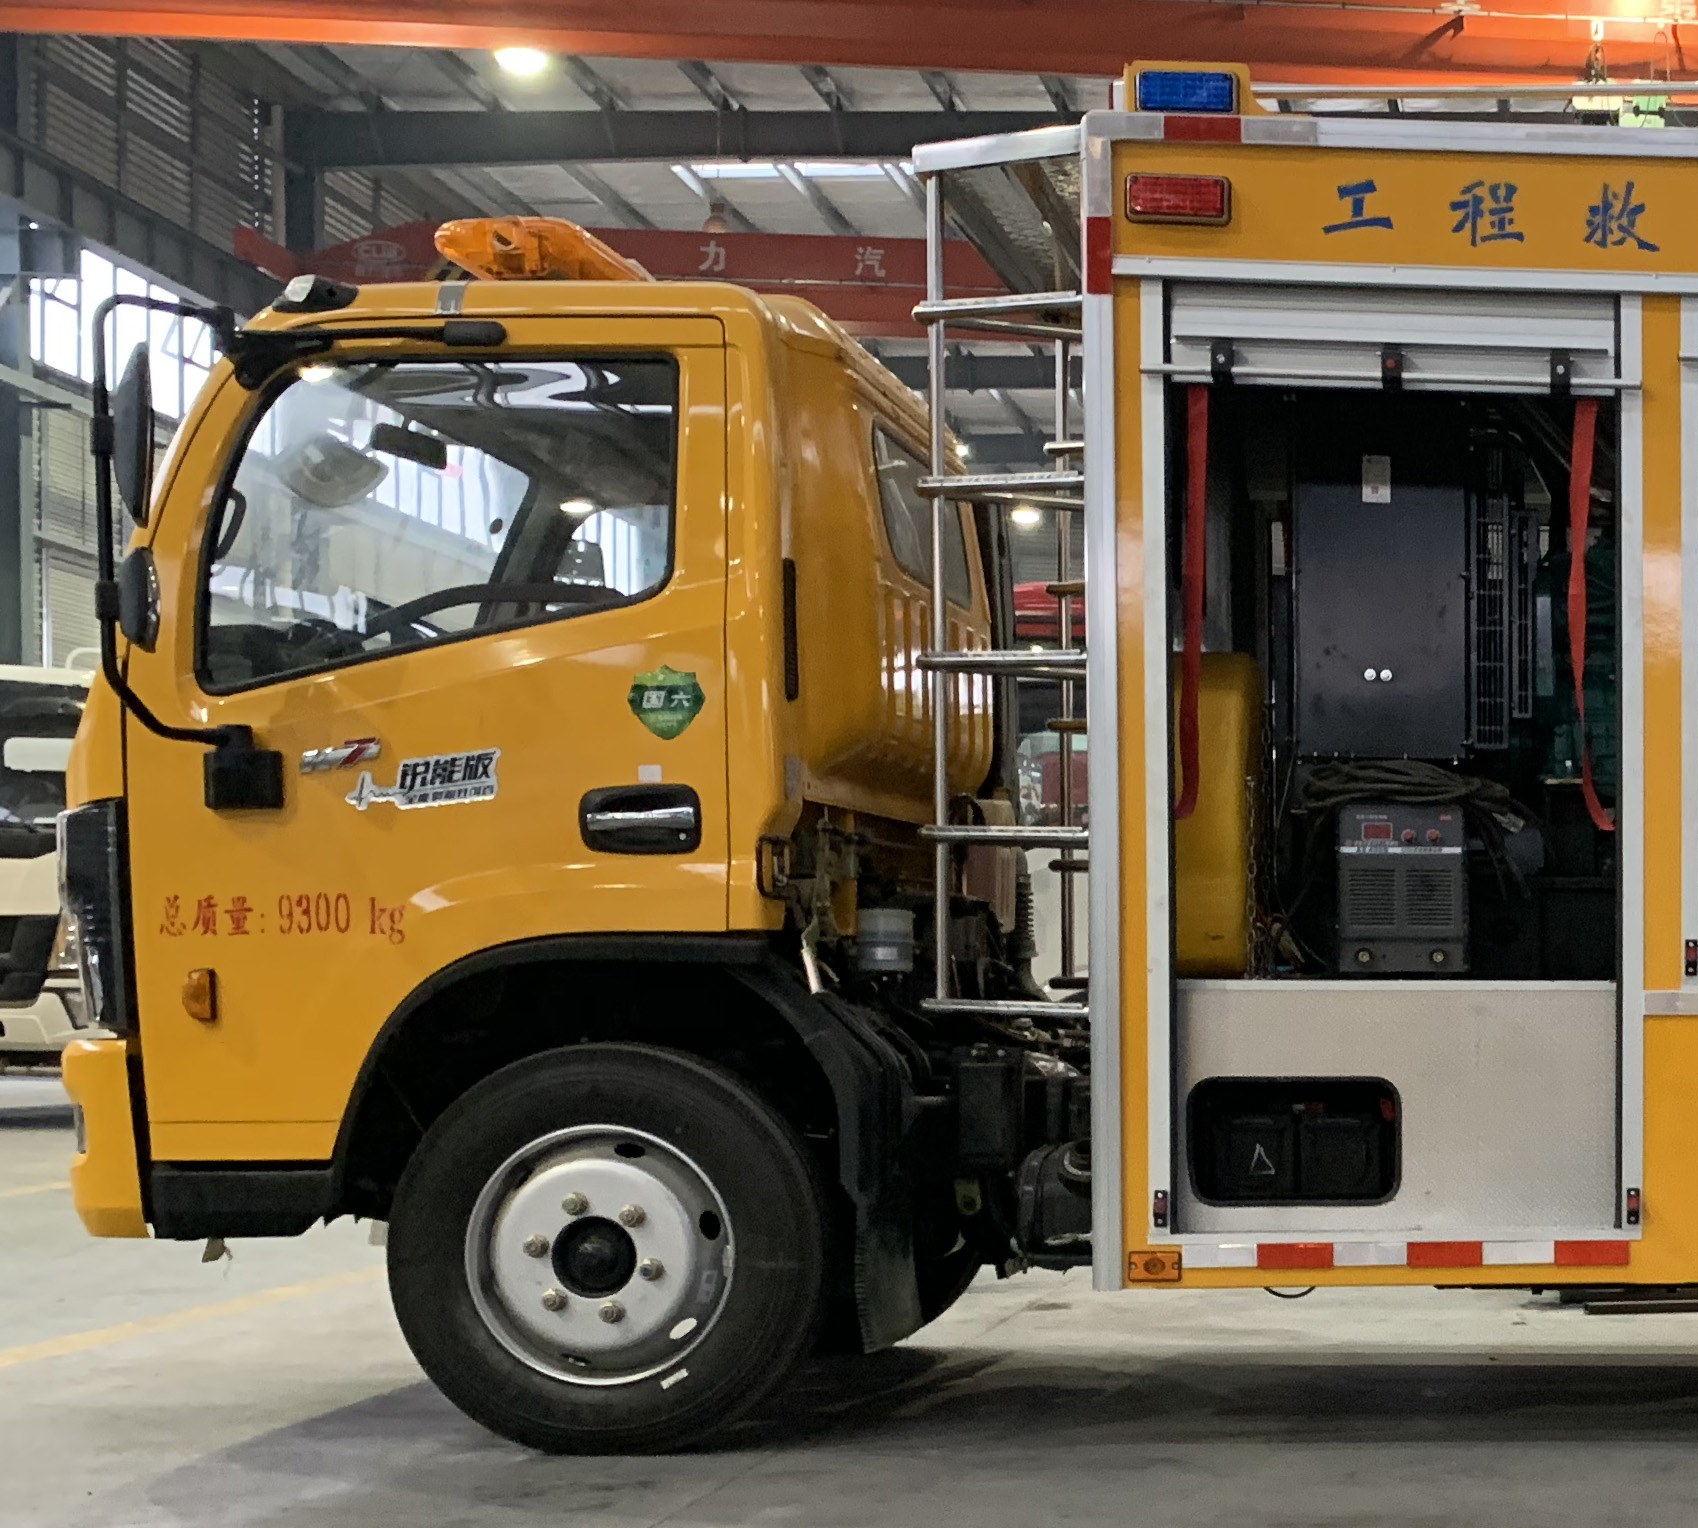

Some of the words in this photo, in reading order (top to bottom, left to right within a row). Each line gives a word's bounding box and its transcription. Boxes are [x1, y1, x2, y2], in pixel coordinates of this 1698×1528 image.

[642, 690, 692, 709] 国六
[278, 892, 351, 935] 9300
[368, 897, 406, 945] kg
